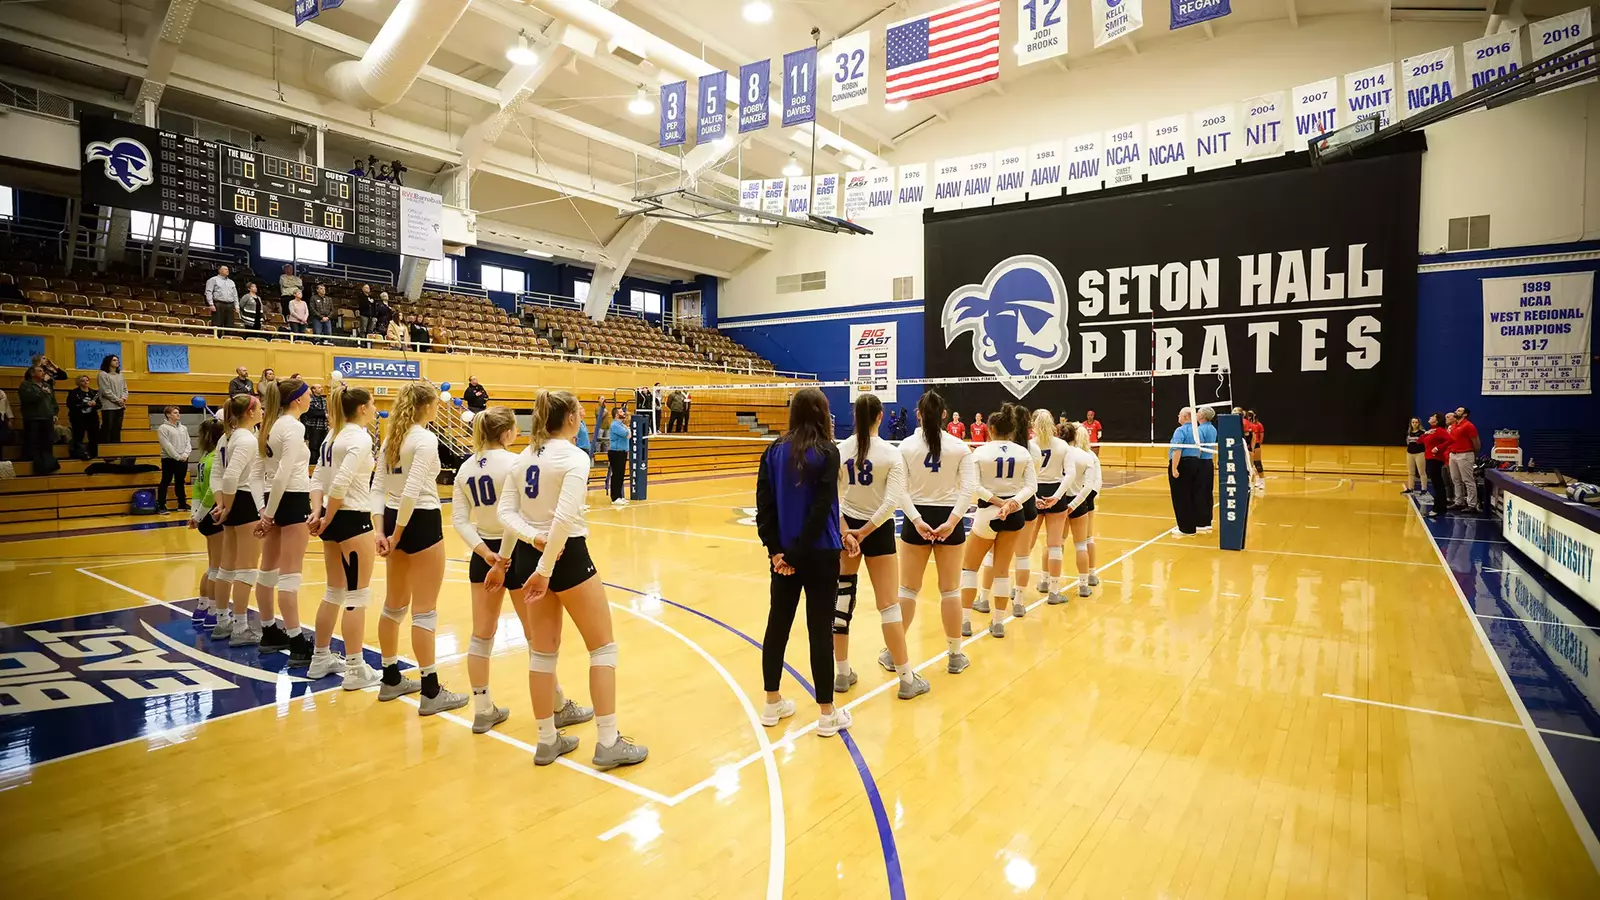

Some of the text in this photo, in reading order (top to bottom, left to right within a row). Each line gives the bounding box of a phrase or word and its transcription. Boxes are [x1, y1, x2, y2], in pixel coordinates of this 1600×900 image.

[1022, 0, 1062, 31] 12
[1106, 4, 1126, 20] KELLY
[1180, 0, 1221, 15] REGAN
[1105, 14, 1128, 31] SMITH
[1033, 29, 1051, 40] JODI
[1107, 26, 1126, 38] SOCCER
[1543, 24, 1580, 45] 2018
[1027, 37, 1058, 52] BROOKS
[1476, 42, 1510, 59] 2016
[834, 49, 865, 83] 32
[1412, 61, 1444, 77] 2015
[791, 63, 808, 94] 11
[842, 80, 858, 91] ROBIN
[1354, 74, 1385, 91] 2014
[748, 73, 760, 103] 8
[832, 87, 867, 102] CUNNINGHAM
[707, 86, 717, 114] 5
[791, 96, 806, 105] BOB
[1302, 91, 1328, 104] 2007
[1349, 88, 1392, 112] WNIT
[1407, 81, 1453, 112] NCAA
[668, 92, 678, 120] 3
[743, 103, 764, 115] BOBBY
[787, 104, 811, 118] DAVIES
[1250, 104, 1275, 116] 2004
[666, 121, 677, 131] PEP
[701, 113, 723, 125] WALTER
[741, 112, 766, 125] WANZER
[1202, 115, 1226, 127] 2003
[1296, 108, 1336, 135] WNIT
[1355, 118, 1390, 132] SIXTEN
[665, 130, 679, 141] SAUL
[701, 124, 721, 135] DUKES
[1112, 131, 1133, 143] 1994
[1156, 125, 1178, 136] 1995
[1246, 121, 1281, 146] NIT
[1074, 143, 1094, 152] 1982
[1197, 132, 1232, 157] NIT
[228, 149, 238, 159] THE
[1001, 157, 1019, 166] 1980
[1036, 151, 1055, 160] 1981
[1107, 143, 1140, 166] NCAA
[1150, 142, 1184, 166] NCAA
[325, 171, 348, 182] GUEST
[941, 166, 957, 174] 1978
[1030, 165, 1060, 186] AIAW
[1069, 158, 1100, 180] AIAW
[824, 178, 835, 186] BIG
[964, 176, 991, 196] AIAW
[996, 171, 1024, 192] AIAW
[237, 188, 255, 197] FOULS
[817, 186, 834, 195] EAST
[869, 190, 893, 207] AIAW
[899, 186, 923, 204] AIAW
[936, 181, 961, 200] AIAW
[789, 199, 808, 212] NCAA
[304, 208, 313, 224] 2
[234, 214, 344, 243] SETON HALL UNIVERSITY
[1078, 242, 1384, 316] SETON HALL
[1522, 281, 1551, 293] 1989
[1520, 296, 1551, 307] NCAA
[1490, 308, 1584, 322] WEST REGIONAL
[861, 329, 885, 338] BIG
[1500, 323, 1571, 336] CHAMPIONS
[858, 336, 891, 346] EAST
[1078, 315, 1382, 374] PIRATES
[1522, 339, 1548, 350] 31-7
[356, 362, 416, 372] PIRATE
[356, 370, 416, 378] BASKETBALL
[321, 442, 334, 467] 14
[924, 452, 941, 472] 4
[1040, 449, 1051, 468] 7
[844, 459, 873, 486] 18
[994, 457, 1015, 478] 11
[525, 465, 540, 498] 9
[1225, 438, 1236, 521] PIRATES
[466, 475, 496, 506] 10
[1517, 509, 1593, 582] SETON HALL UNIVERSITY
[24, 628, 240, 700] EAST
